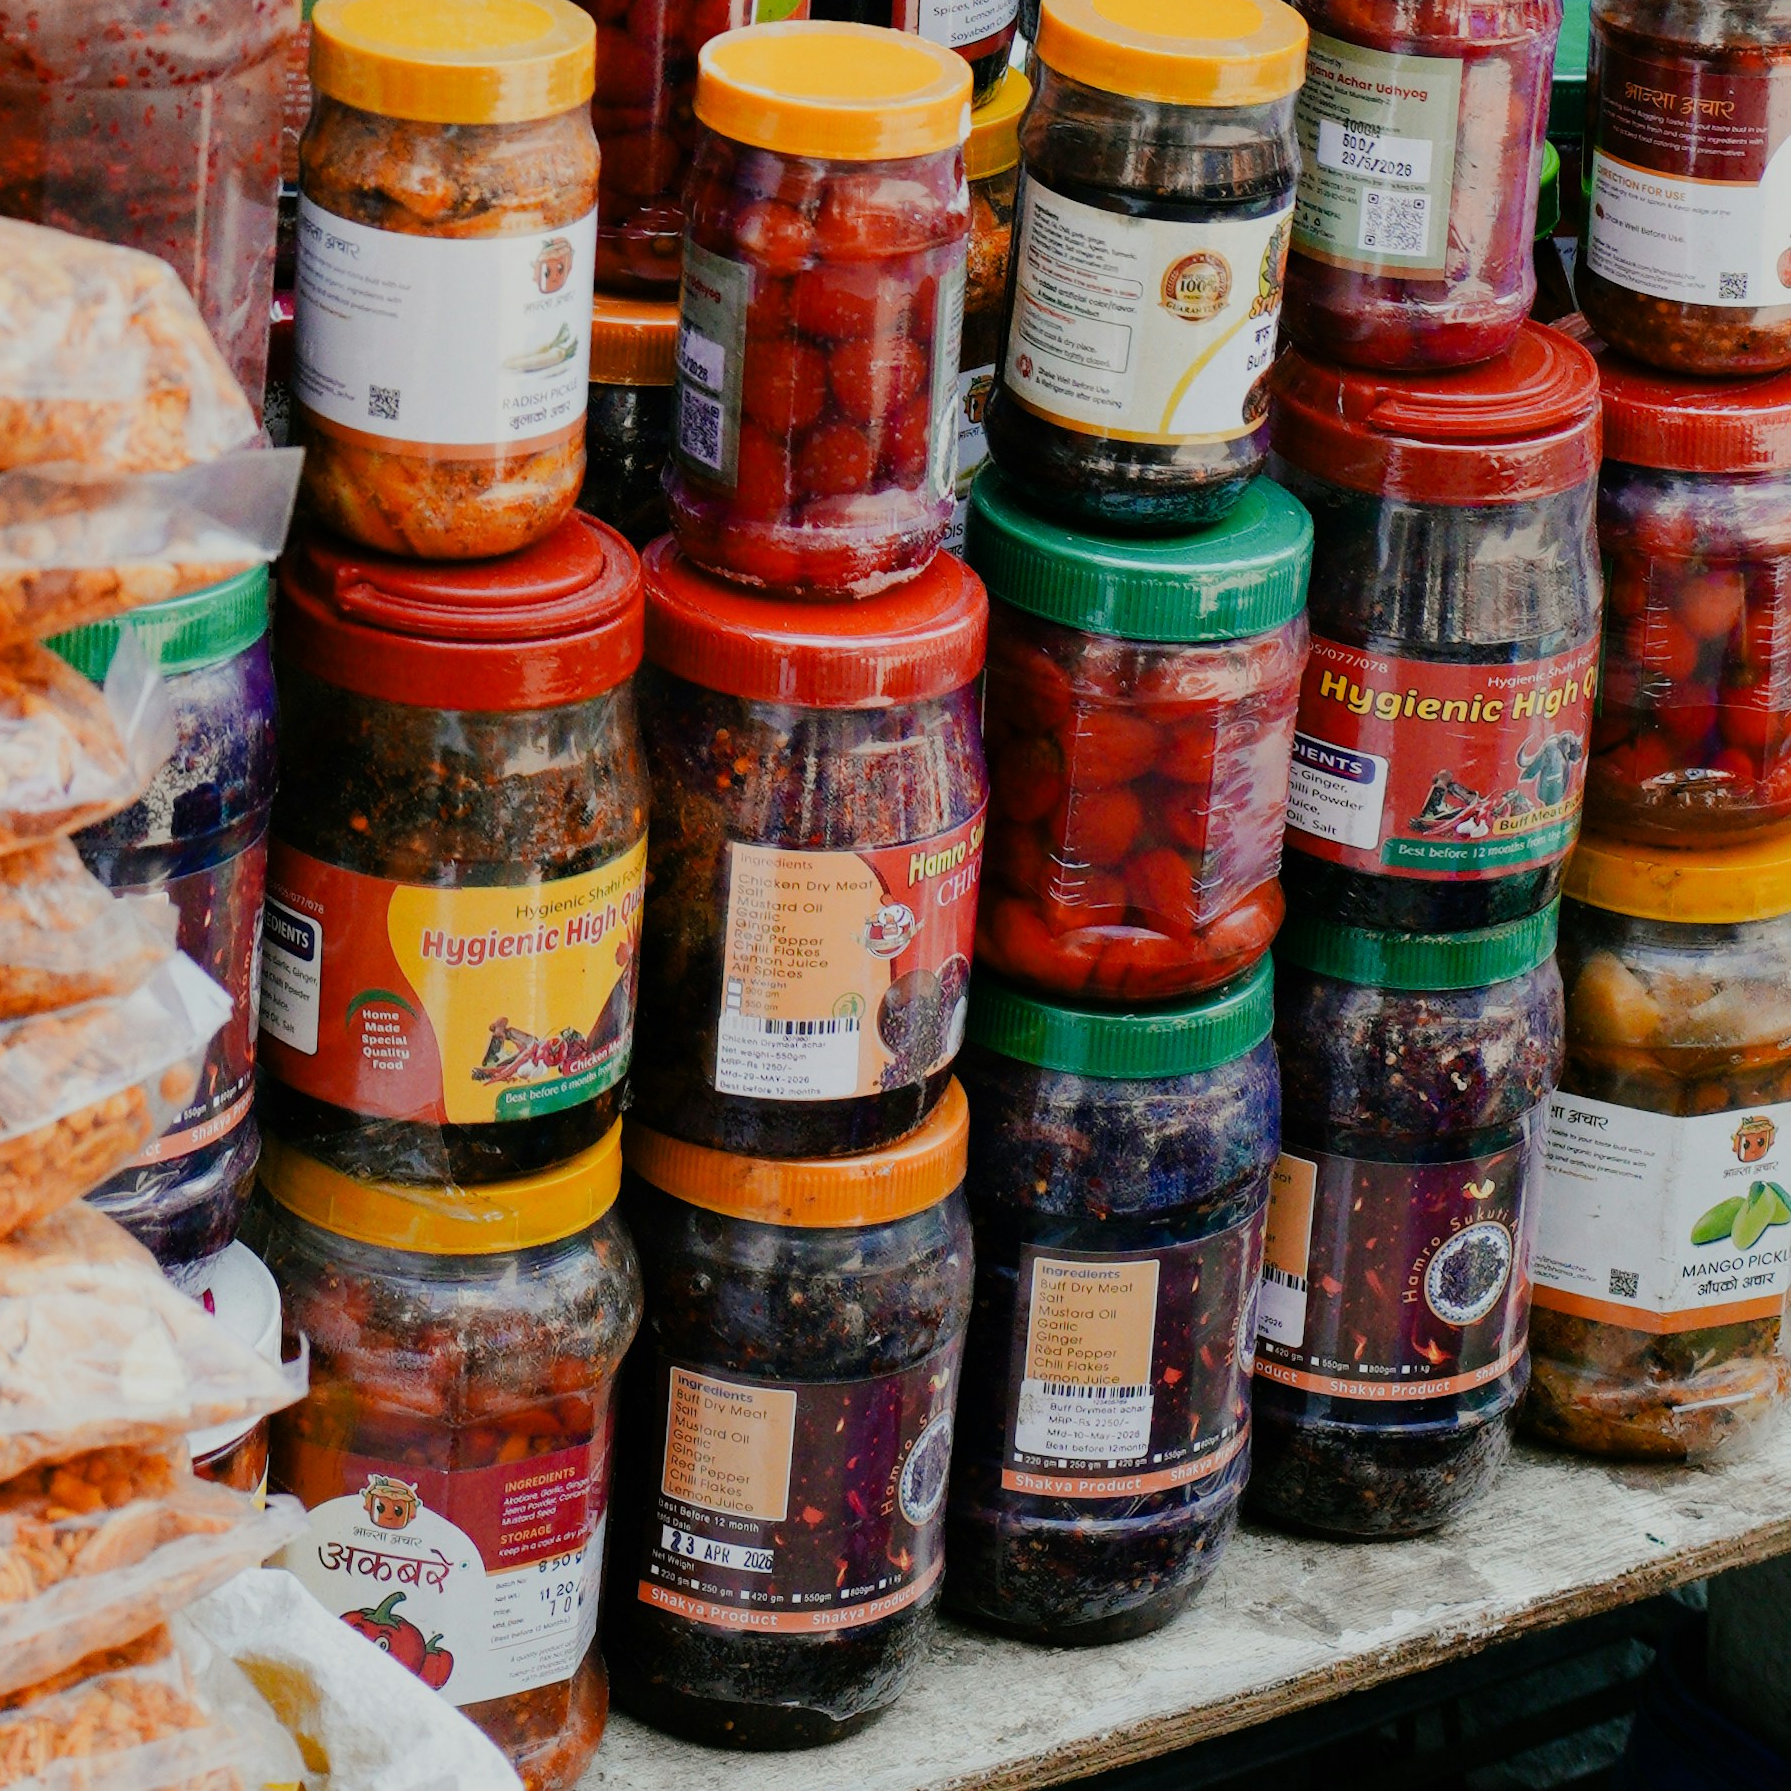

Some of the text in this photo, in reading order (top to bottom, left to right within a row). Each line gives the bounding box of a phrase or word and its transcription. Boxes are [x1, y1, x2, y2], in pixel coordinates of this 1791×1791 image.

[1337, 74, 1429, 103] Achar Udhyog
[1678, 95, 1735, 120] अचार
[1641, 183, 1662, 198] FOR
[1665, 188, 1687, 203] USE
[502, 385, 549, 411] RADISH
[1488, 671, 1545, 690] Hygienic
[1320, 669, 1579, 723] Hygienic High
[1302, 769, 1349, 794] Ginger,
[1311, 787, 1365, 812] Powder
[1311, 818, 1338, 836] Salt
[1500, 813, 1528, 831] Buff
[741, 852, 813, 871] Ingredients
[1398, 843, 1426, 858] Best
[1428, 845, 1468, 860] before
[1472, 847, 1486, 859] 12
[908, 842, 966, 889] Hamro
[737, 885, 763, 897] Salt
[738, 873, 874, 894] Chicken Dry Meat
[516, 878, 622, 920] Hygienic Shahi
[736, 895, 823, 914] Mustard Oil
[736, 907, 781, 923] Garlic
[421, 926, 560, 967] Hygienic
[565, 903, 618, 947] High
[736, 918, 787, 936] Ginger
[734, 928, 824, 948] Red Pepper
[732, 950, 828, 969] Lemon Juice
[773, 946, 820, 959] Flakes
[732, 961, 804, 980] All Spices
[362, 1009, 400, 1021] Home
[365, 1021, 401, 1033] Made
[361, 1033, 409, 1046] Special
[363, 1047, 411, 1060] Quality
[569, 1048, 608, 1074] Chicken
[372, 1059, 404, 1071] Food
[505, 1089, 527, 1104] Best
[529, 1085, 560, 1101] before
[1567, 1107, 1610, 1132] अचार
[1401, 1204, 1511, 1305] Hamro Sukuti
[1041, 1264, 1121, 1280] Ingredients
[1682, 1256, 1745, 1280] MANGO
[1040, 1278, 1134, 1295] Buff Dry Meat
[1742, 1271, 1776, 1289] अचार
[1039, 1291, 1064, 1304] Salt
[1038, 1304, 1117, 1320] Mustard Oil
[1037, 1318, 1078, 1332] Garlic
[1036, 1331, 1083, 1347] Ginger
[1034, 1343, 1118, 1362] Red Pepper
[1067, 1360, 1110, 1373] Flakes
[1083, 1373, 1121, 1386] Juice
[1329, 1357, 1509, 1399] Shakya Product Shakya
[677, 1373, 754, 1404] Ingredients
[675, 1401, 698, 1418] Salt
[704, 1397, 726, 1415] Dry
[729, 1404, 768, 1420] Meat
[673, 1428, 711, 1450] Garlic
[674, 1414, 750, 1445] Mustard Oil
[672, 1441, 716, 1465] Ginger
[1025, 1455, 1042, 1466] 220
[504, 1466, 576, 1493] INGREDIENTS
[670, 1454, 751, 1487] Red Pepper
[1014, 1457, 1213, 1494] Shakya Product Shakya
[668, 1479, 755, 1514] Lemon Juice
[700, 1477, 743, 1498] Flakes
[672, 1516, 692, 1533] Date
[679, 1504, 761, 1534] Before 12 month
[500, 1523, 552, 1546] STORAGE
[667, 1553, 696, 1573] Weight
[703, 1542, 775, 1571] APR 2026
[317, 1542, 455, 1594] अकबरे
[701, 1582, 718, 1596] 250
[719, 1586, 735, 1599] gm
[751, 1590, 769, 1603] 420
[770, 1593, 785, 1605] gm
[651, 1583, 916, 1627] Shakya Product Shakya Product
